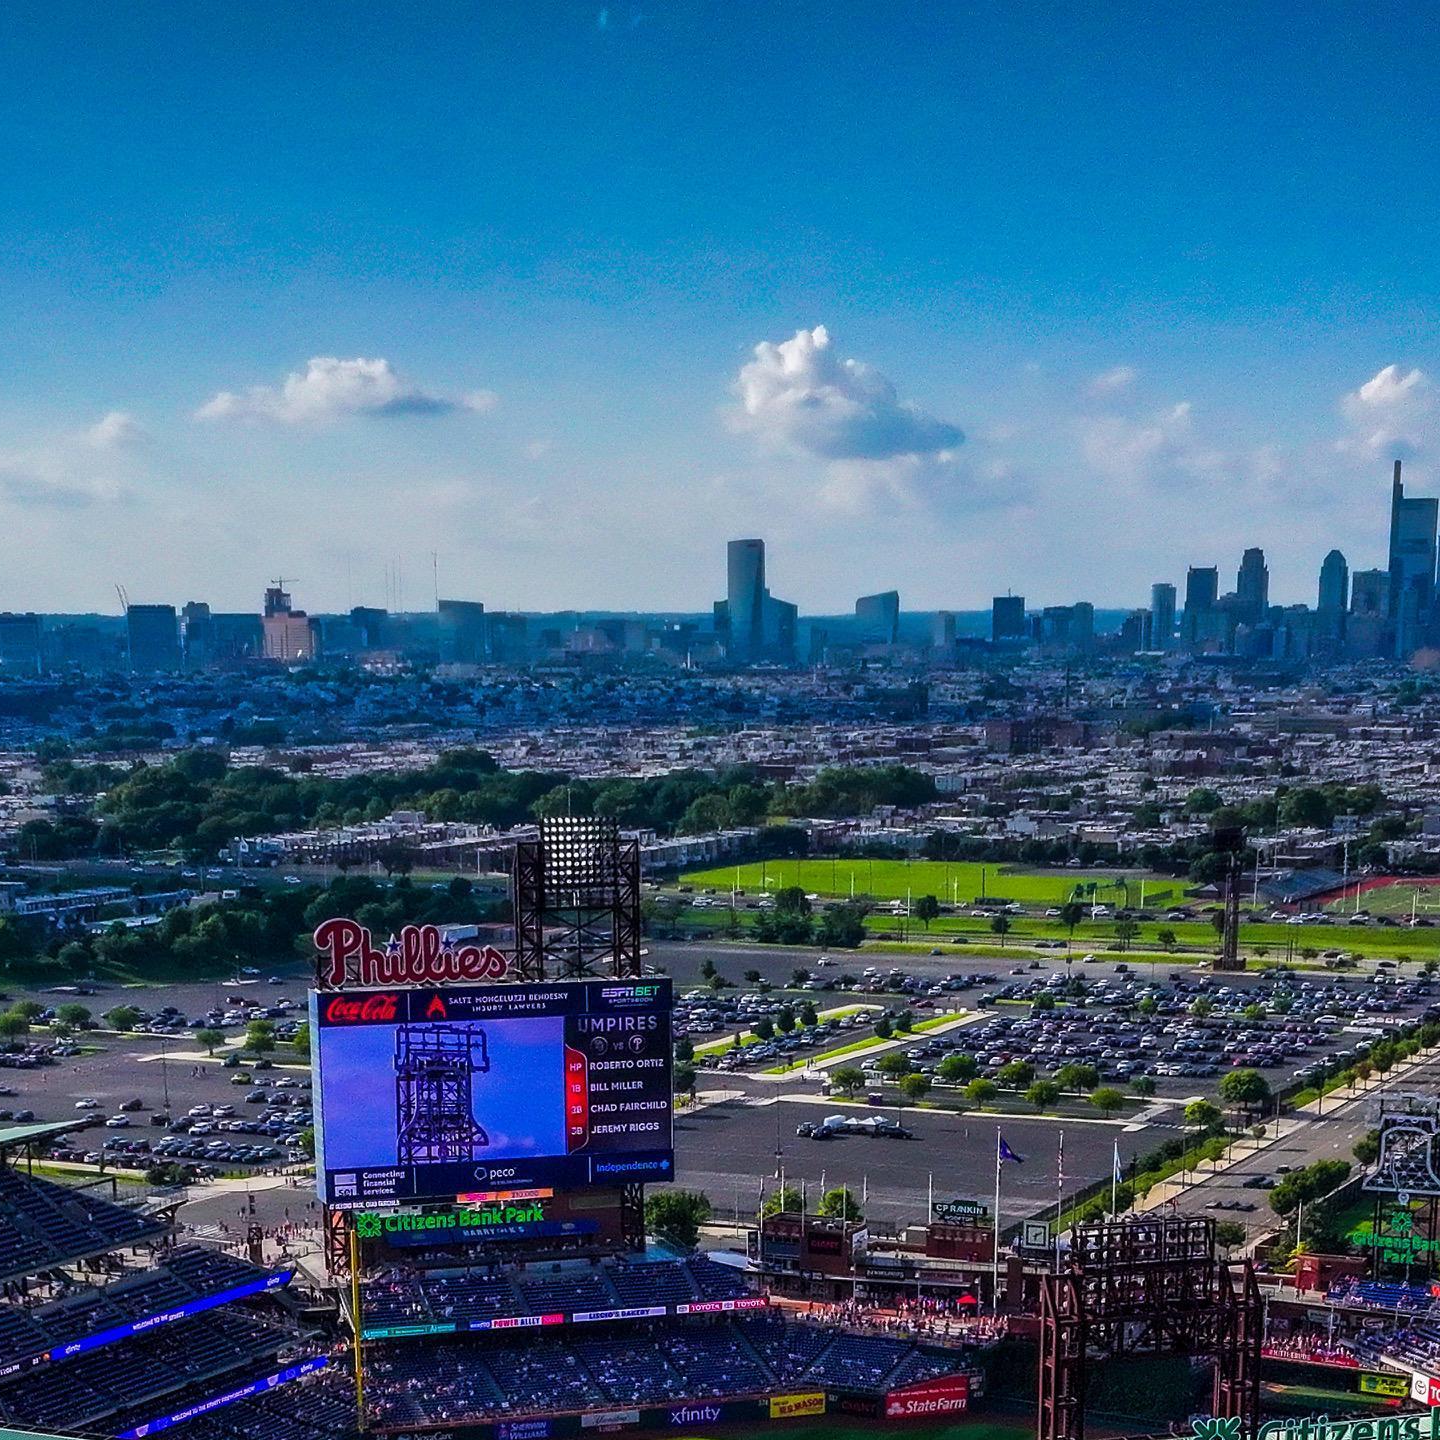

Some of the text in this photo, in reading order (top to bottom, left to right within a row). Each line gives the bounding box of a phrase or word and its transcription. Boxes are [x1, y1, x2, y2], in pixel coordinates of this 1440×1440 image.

[315, 917, 508, 986] Phillies
[327, 993, 398, 1021] Coca-Cola
[509, 1002, 546, 1011] LAWYERS
[578, 1015, 657, 1033] UMPIRES
[570, 1058, 664, 1072] HP ROBERTO ORTIZ
[571, 1081, 643, 1093] 1B BILL MILLER
[591, 1103, 617, 1113] CHAD
[620, 1101, 667, 1111] FAIRCHILD
[591, 1124, 627, 1134] JEREMY
[630, 1122, 660, 1132] RIGGS
[596, 1160, 658, 1173] Independence
[363, 1170, 405, 1180] Connecting
[490, 1168, 515, 1180] peco
[363, 1178, 396, 1187] financial
[363, 1187, 395, 1196] services.
[935, 1204, 983, 1215] CP RANKIN
[385, 1205, 545, 1232] Citizens Bank Park
[463, 1227, 494, 1237] HARRY
[1352, 1231, 1410, 1248] Citizens
[1383, 1249, 1417, 1265] Park
[691, 1299, 765, 1312] TOYOTA TOYOTA
[589, 1308, 650, 1320] LISCIO'S BAKERY
[494, 1318, 519, 1328] POWER
[520, 1316, 541, 1326] ALLEY
[906, 1397, 966, 1414] State Farm
[671, 1405, 721, 1425] xfinity
[510, 1420, 547, 1432] SHERWIN
